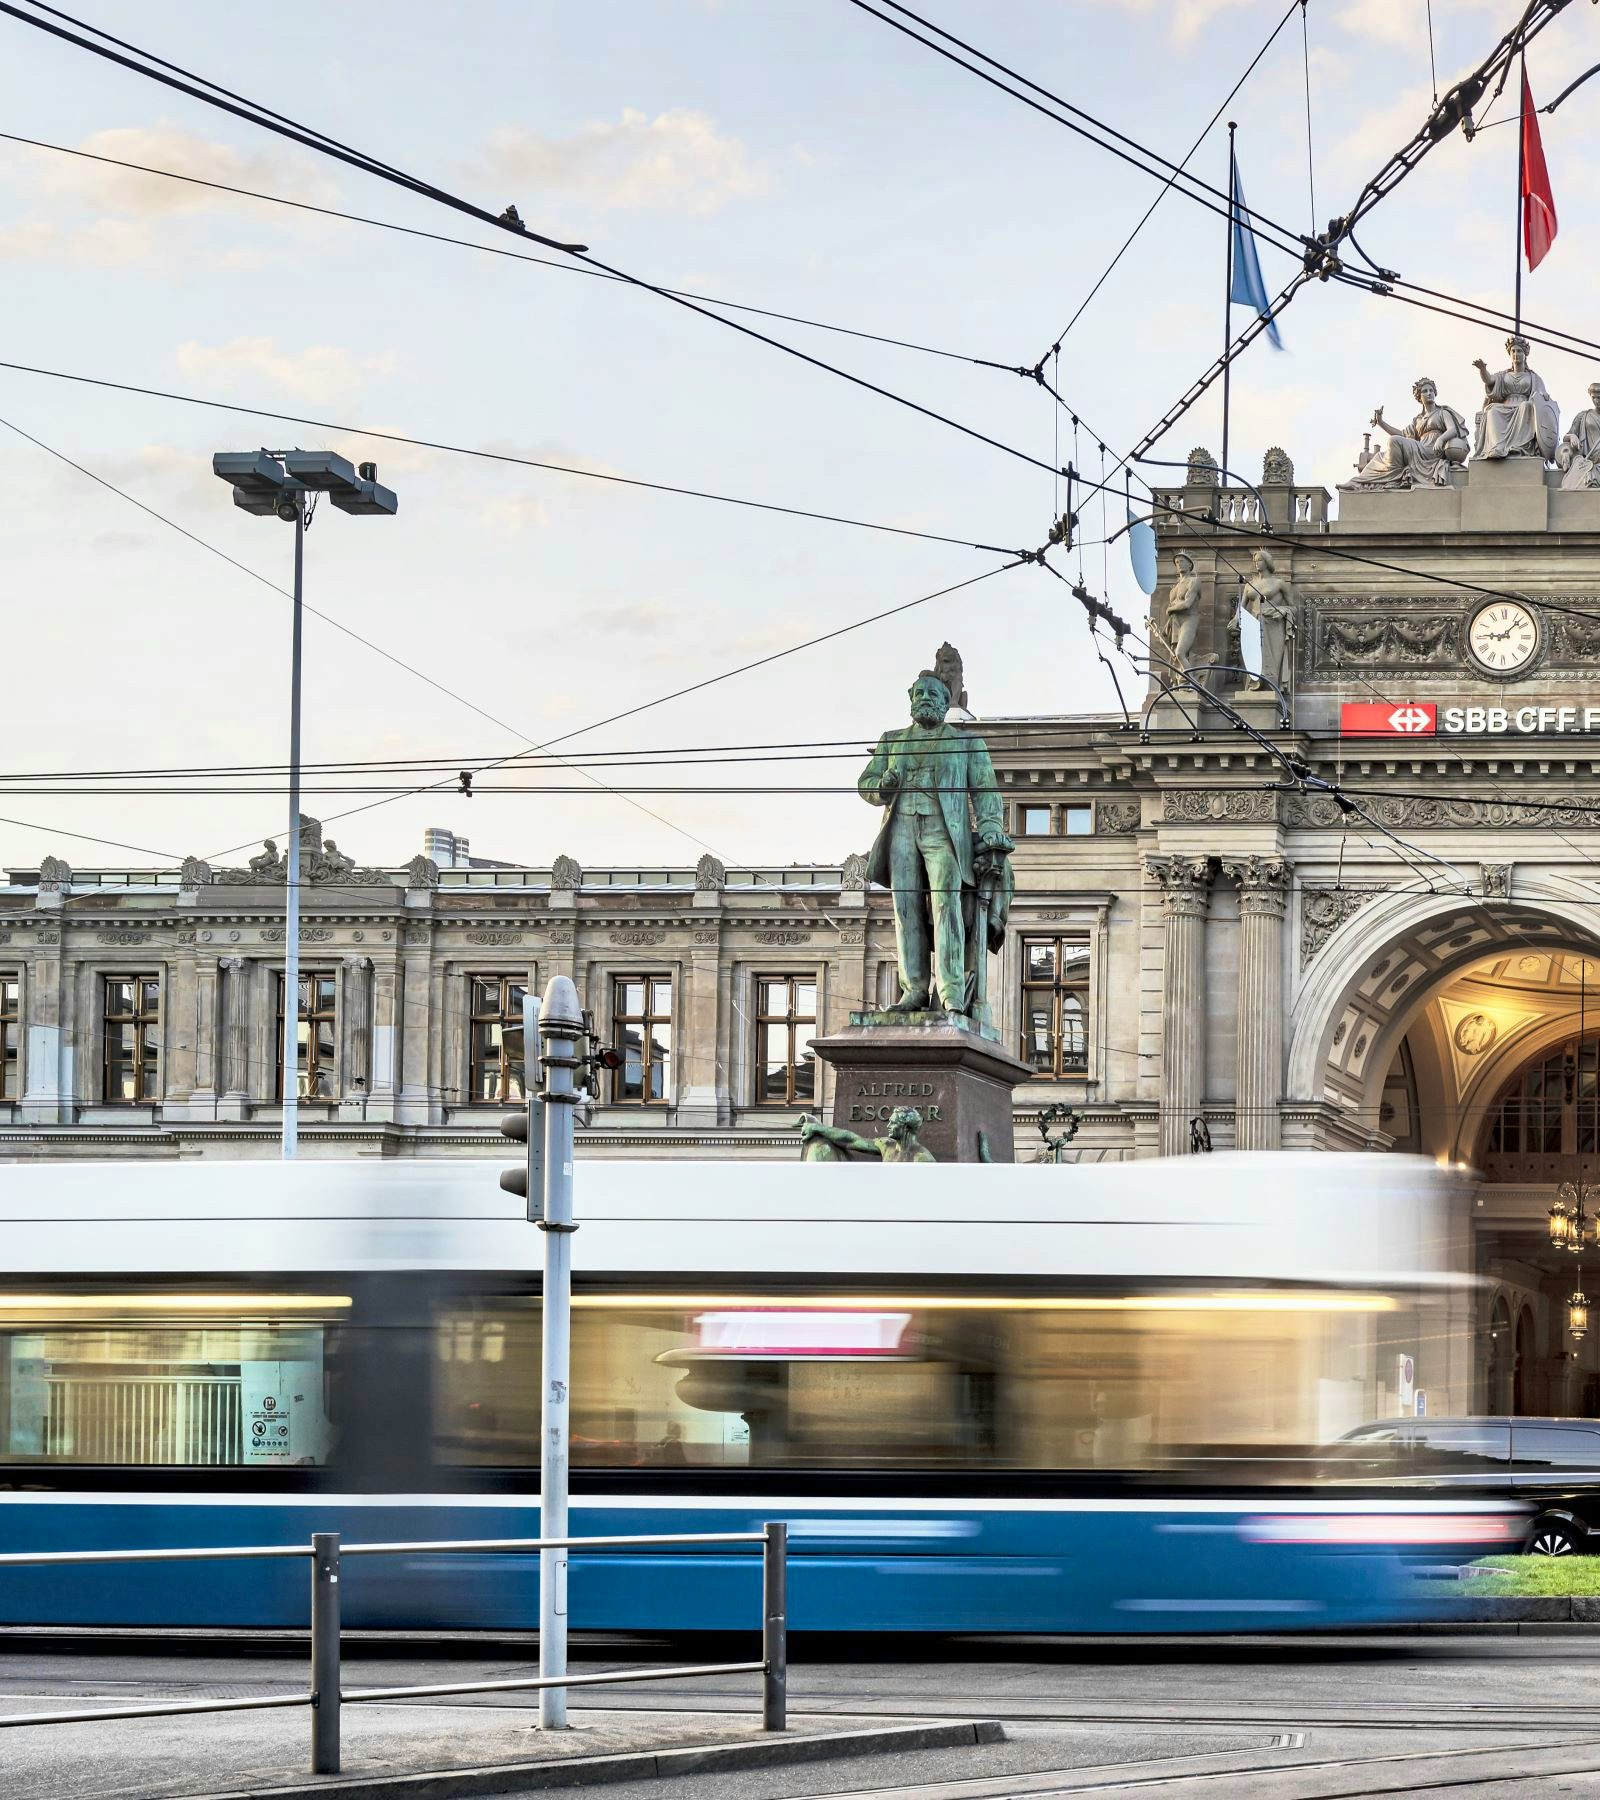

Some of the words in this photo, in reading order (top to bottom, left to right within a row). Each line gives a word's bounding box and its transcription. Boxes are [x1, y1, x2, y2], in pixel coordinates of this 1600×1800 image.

[1444, 706, 1509, 733] SBB
[1515, 706, 1577, 733] CFF
[857, 1082, 935, 1097] ALFRED
[848, 1104, 943, 1122] ESCR
